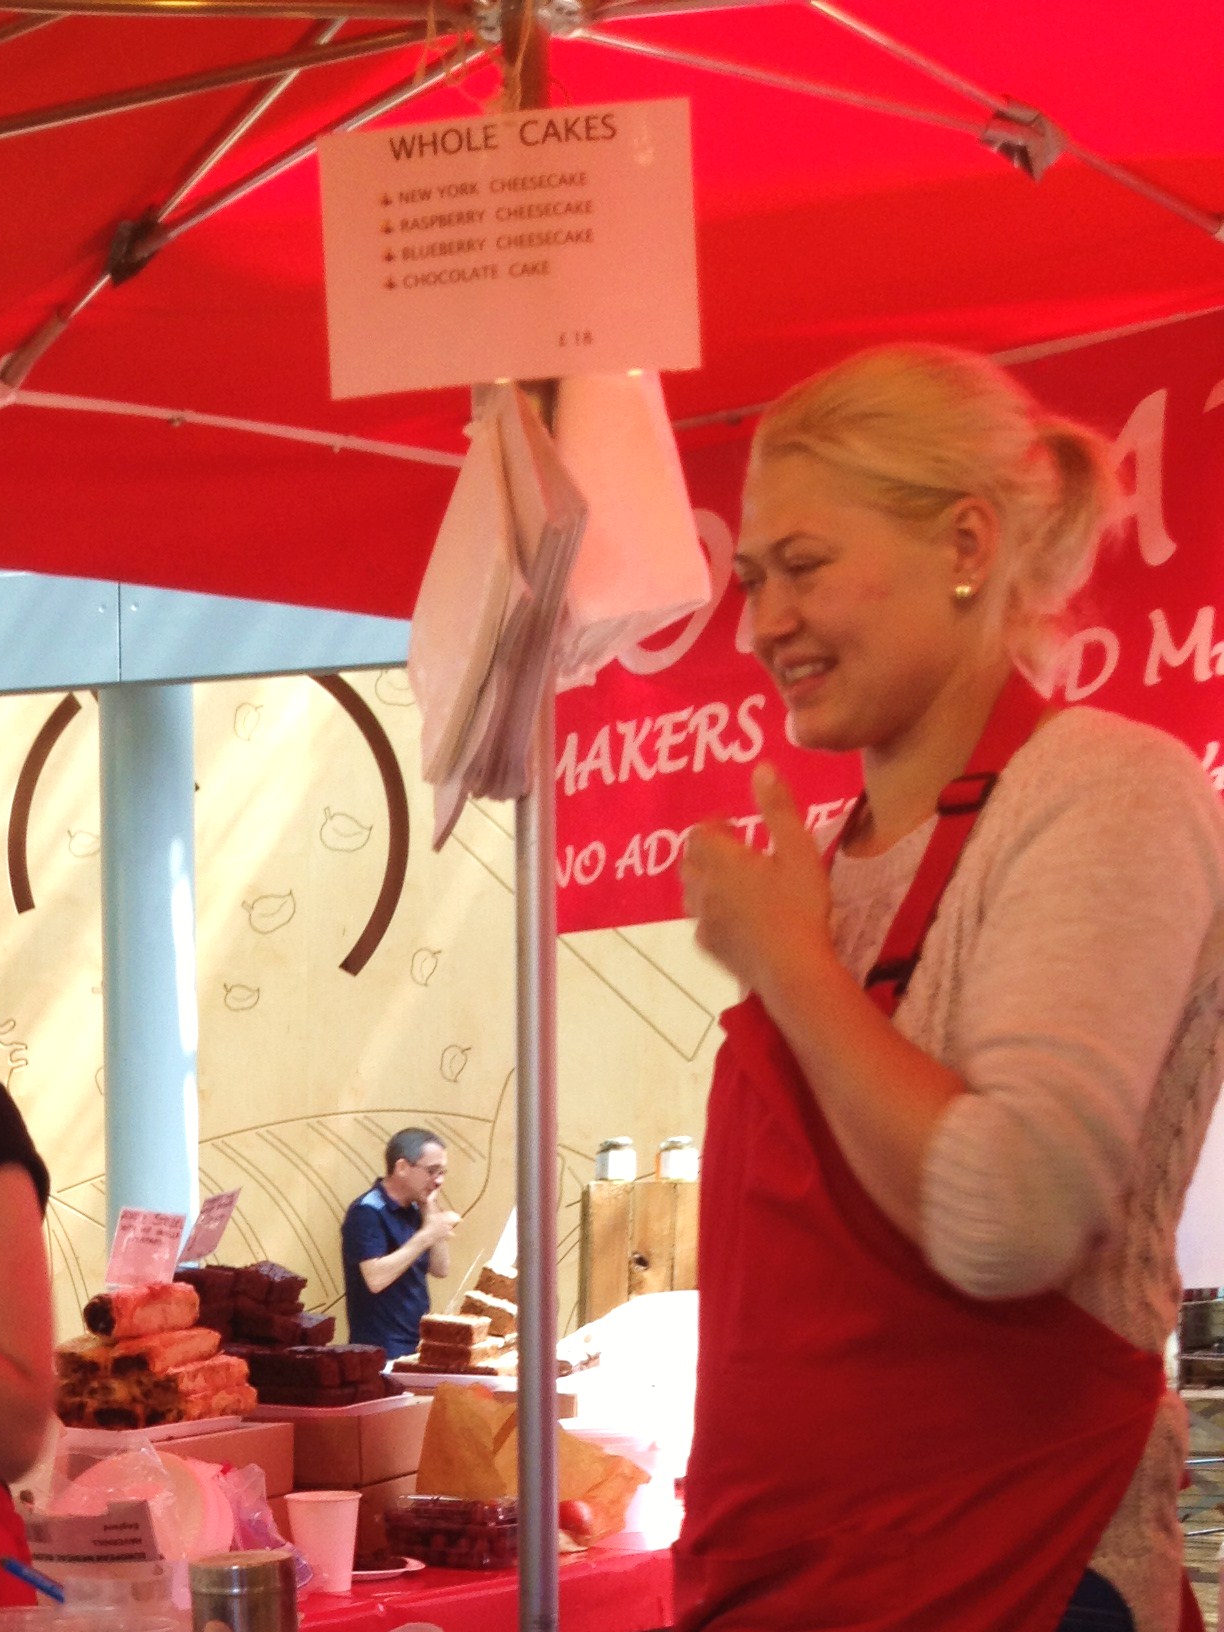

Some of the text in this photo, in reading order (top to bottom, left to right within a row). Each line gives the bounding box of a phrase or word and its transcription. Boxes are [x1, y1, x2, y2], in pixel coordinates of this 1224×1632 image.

[389, 113, 617, 160] WHOLE CAKES
[399, 172, 587, 204] NEW YORK CHEESECAKE
[400, 200, 593, 232] RASPBERRY CHEESECAKE
[402, 228, 594, 261] BLUEBERRY CHEESECAKE
[403, 260, 550, 289] CHOCOLATE CAKE
